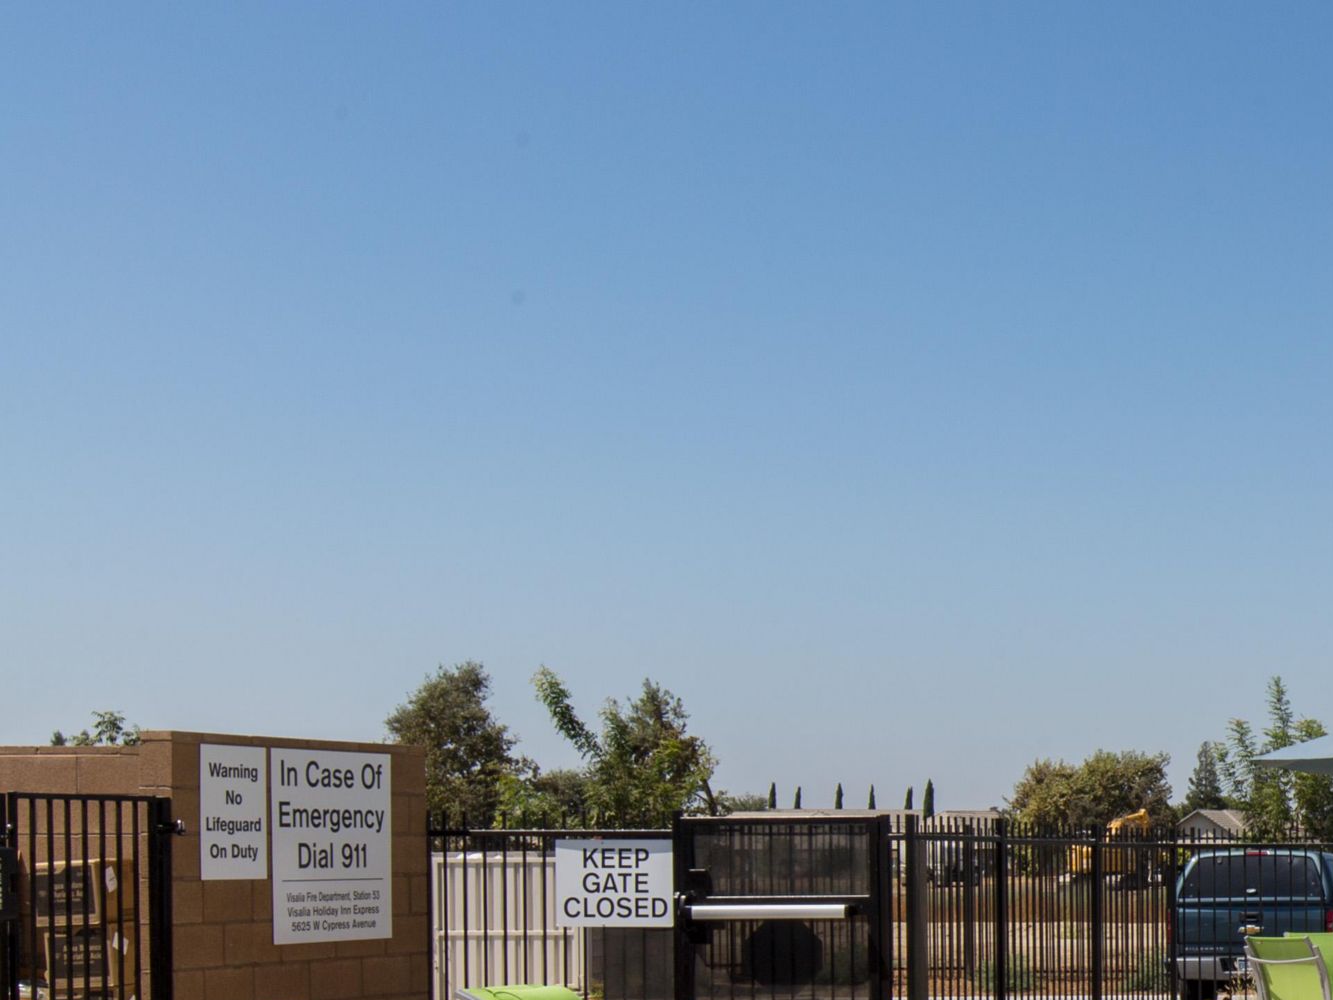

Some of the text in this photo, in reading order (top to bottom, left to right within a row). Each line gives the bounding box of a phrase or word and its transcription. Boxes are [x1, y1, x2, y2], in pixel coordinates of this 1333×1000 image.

[209, 762, 258, 782] Warning
[280, 760, 382, 789] In Case Of
[226, 790, 242, 805] No
[206, 817, 261, 835] Lifeguard
[279, 802, 384, 833] Emergency
[210, 844, 258, 862] On Duty
[298, 843, 367, 869] Dial 911
[583, 848, 649, 868] KEEP
[582, 872, 649, 893] GATE
[288, 904, 379, 917] Visalia Holiday Inn Express
[564, 897, 668, 918] CLOSED
[313, 920, 320, 930] W
[322, 920, 350, 932] Cypress
[352, 919, 376, 929] Avenue
